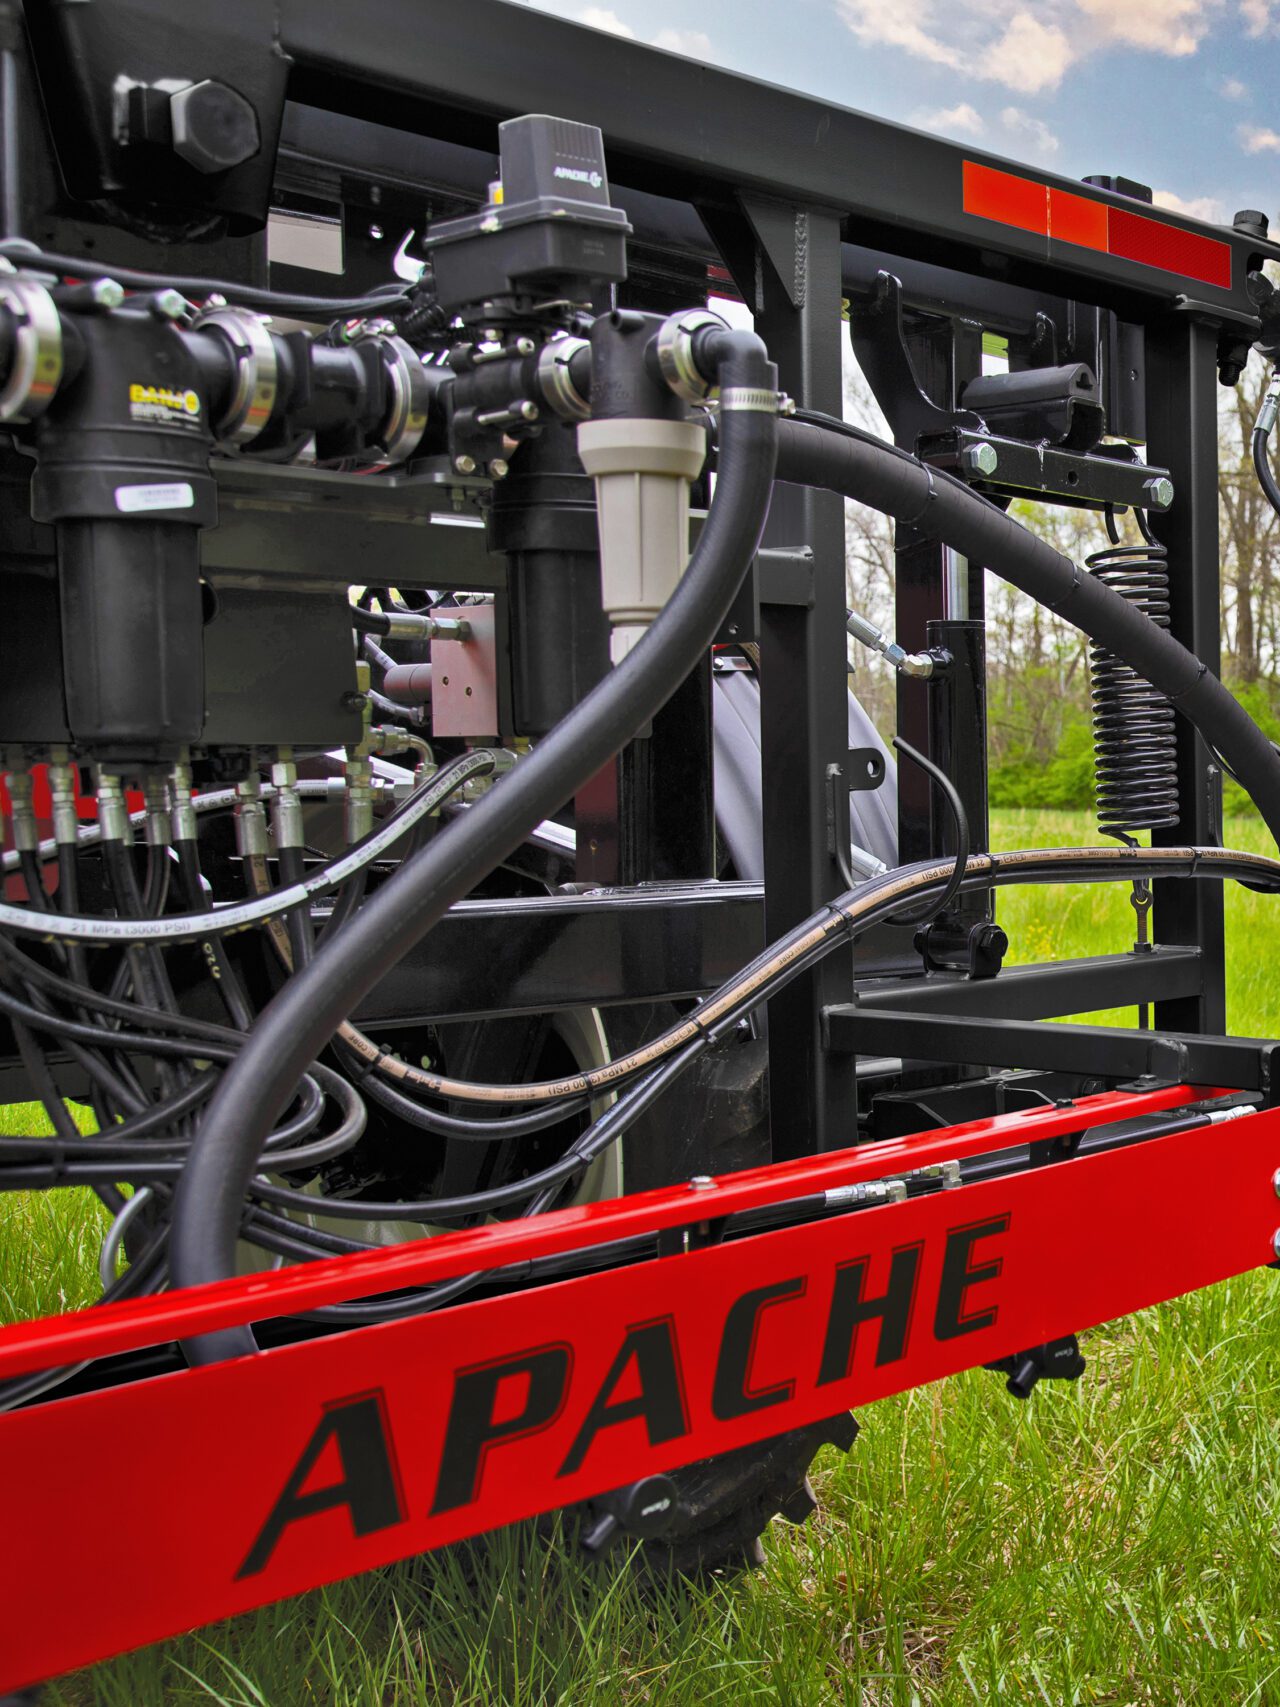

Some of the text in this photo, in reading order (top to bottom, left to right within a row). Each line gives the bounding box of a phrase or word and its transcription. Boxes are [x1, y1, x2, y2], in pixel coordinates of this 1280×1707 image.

[71, 923, 87, 934] 21
[92, 923, 122, 935] MPa
[625, 1057, 638, 1069] 21
[601, 1063, 625, 1079] MPa
[572, 1074, 602, 1090] (300
[548, 1083, 571, 1096] PSI)
[233, 1212, 1011, 1583] APACHE
